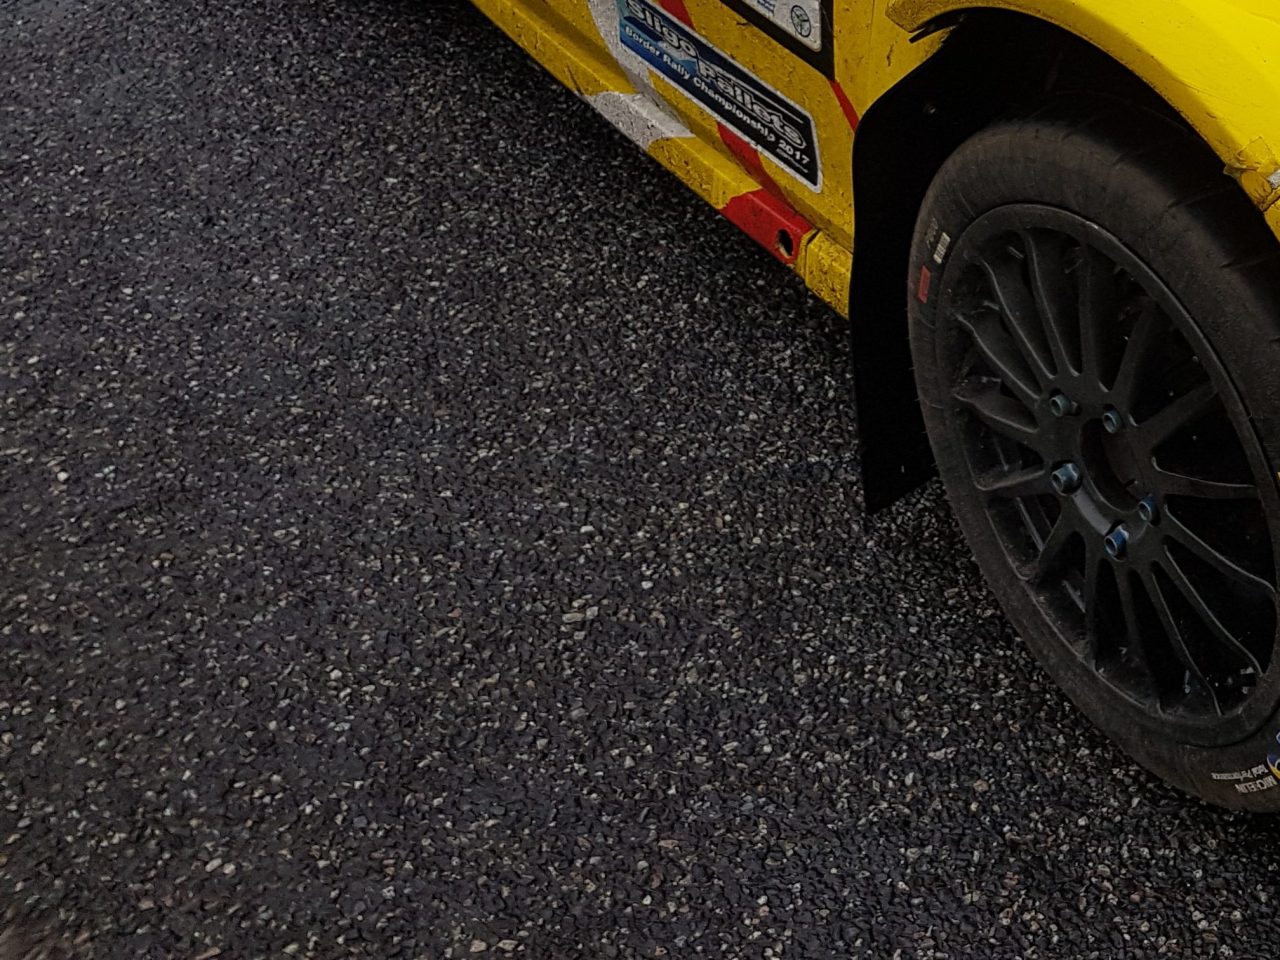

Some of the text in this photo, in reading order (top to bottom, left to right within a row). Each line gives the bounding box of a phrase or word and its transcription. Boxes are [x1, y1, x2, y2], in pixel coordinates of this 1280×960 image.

[624, 26, 661, 58] Border
[662, 54, 691, 81] Rally
[693, 76, 776, 143] Championship
[777, 139, 811, 165] 2017
[698, 59, 807, 150] Pallets
[1235, 775, 1278, 793] MICHELIN
